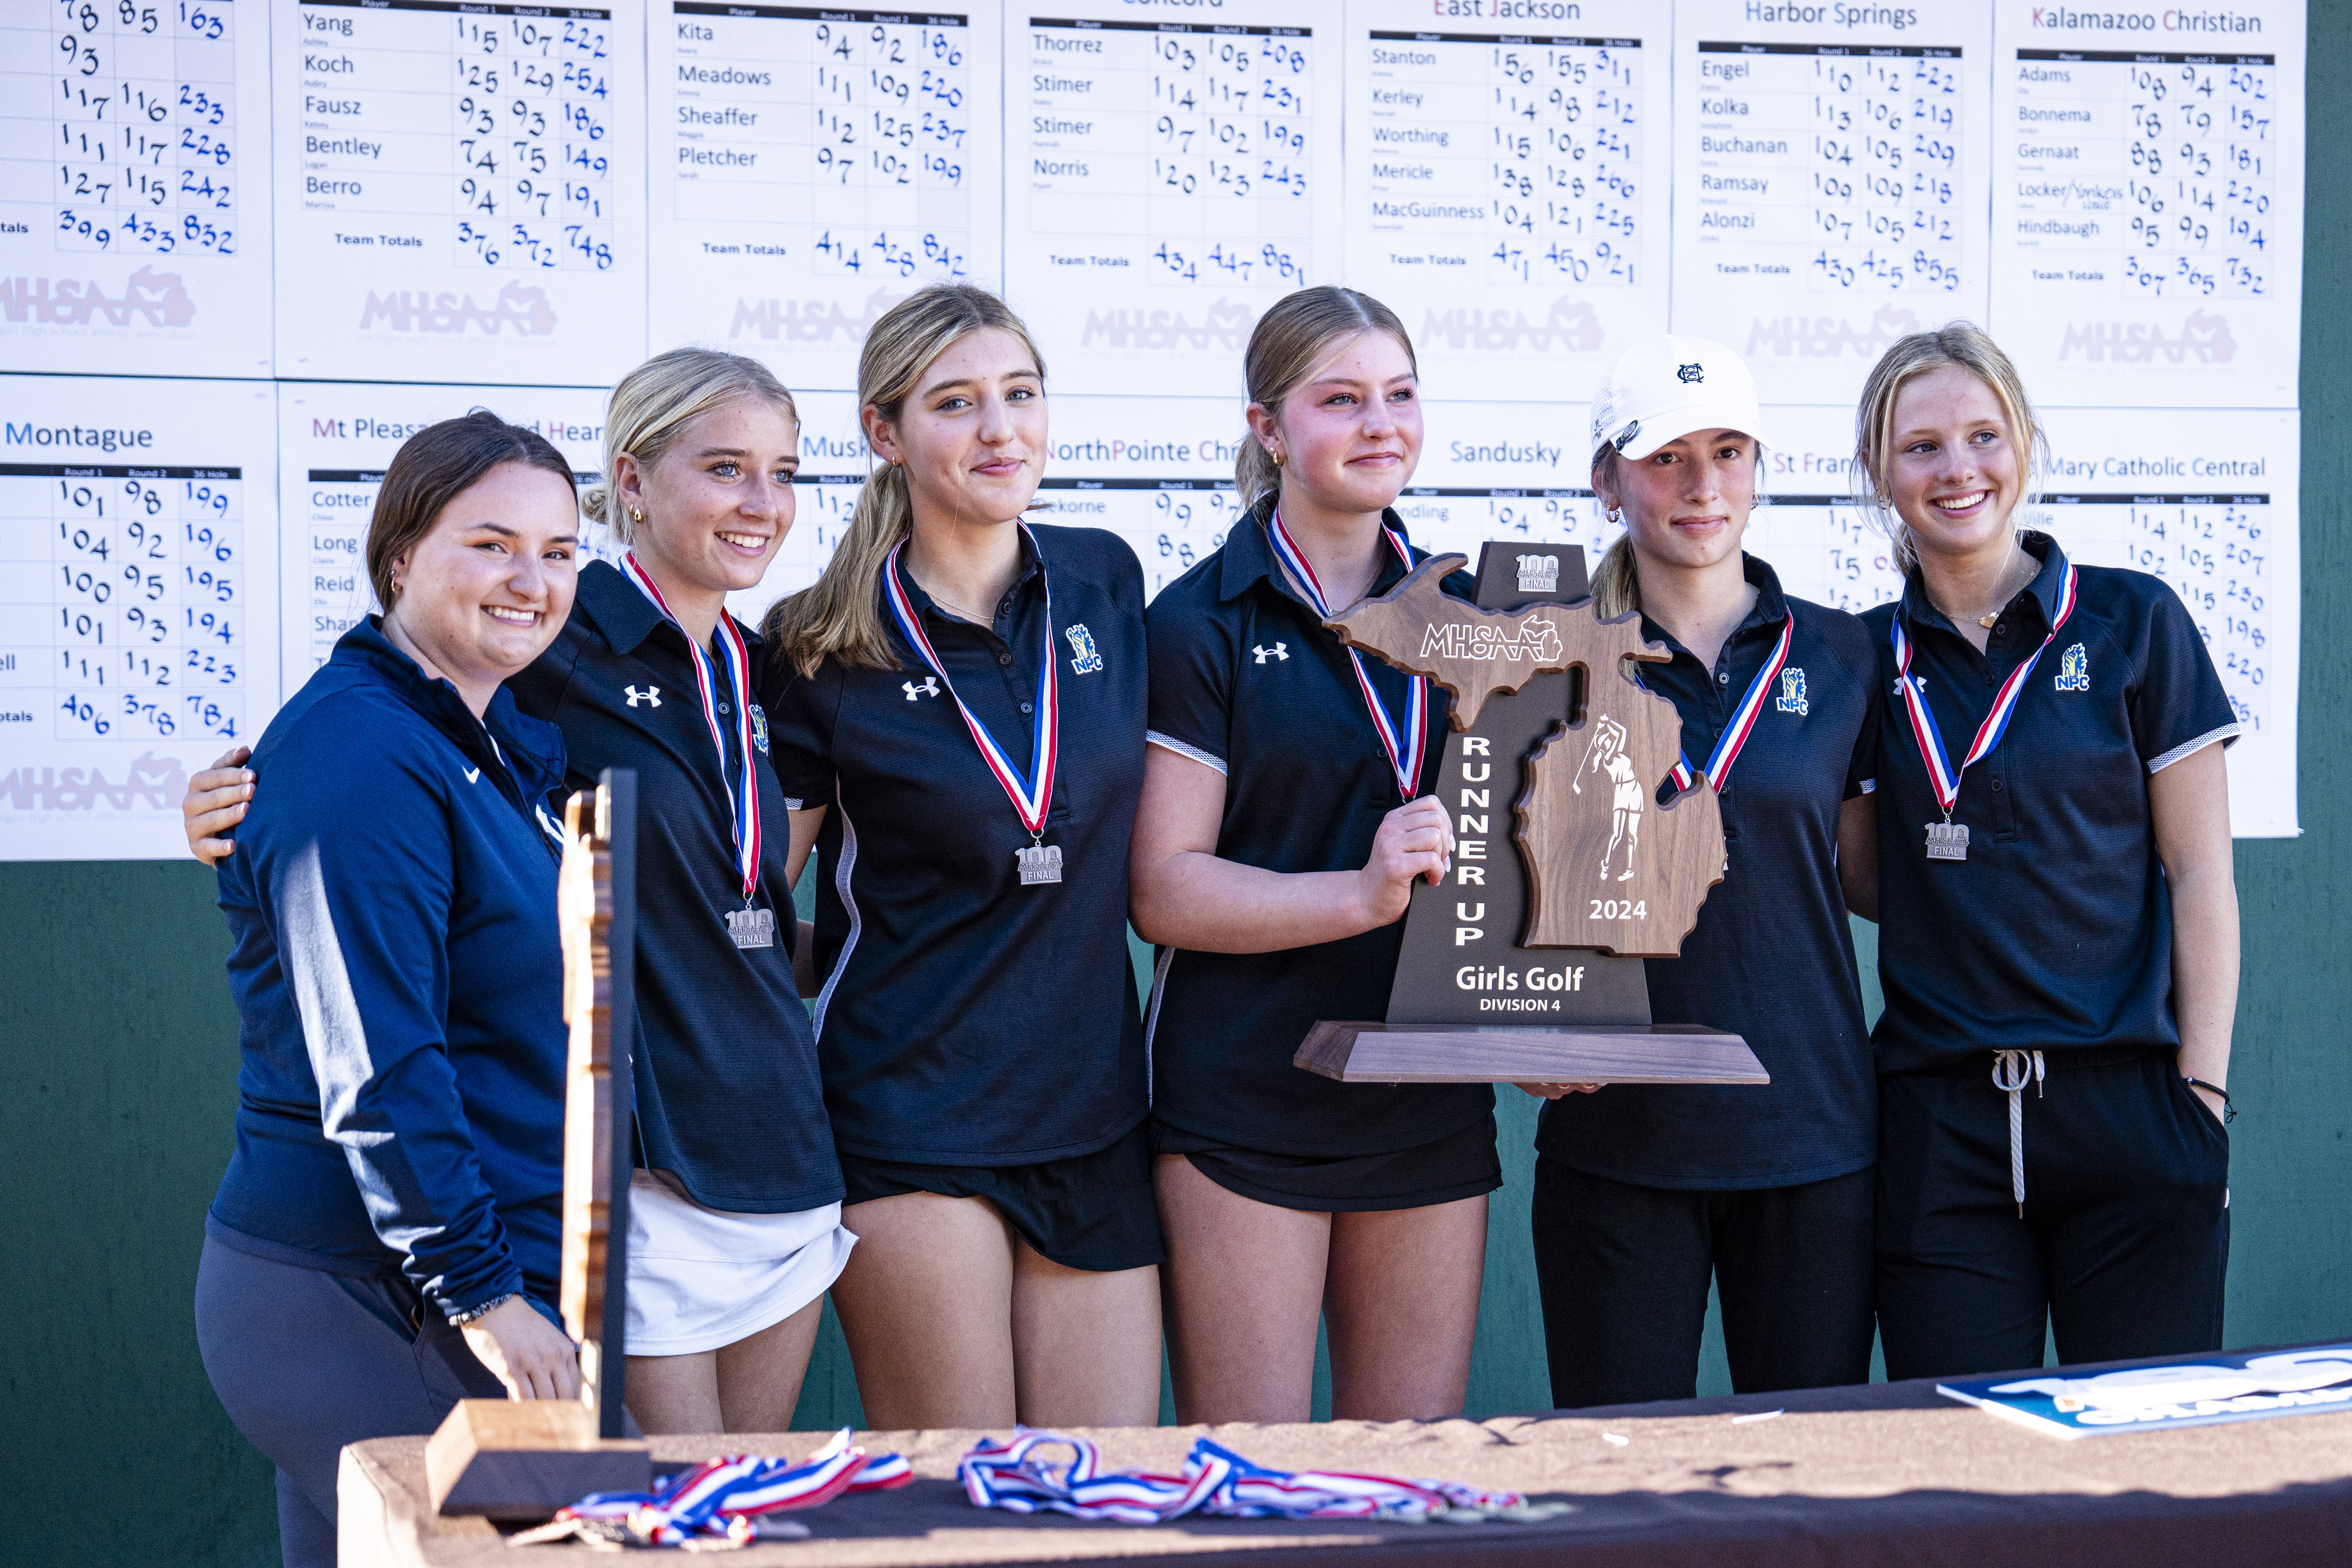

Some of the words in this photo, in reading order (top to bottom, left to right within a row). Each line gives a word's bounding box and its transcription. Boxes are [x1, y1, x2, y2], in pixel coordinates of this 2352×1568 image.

[459, 6, 489, 15] Round
[490, 6, 499, 15] 1
[513, 7, 542, 16] Round
[543, 7, 551, 17] 2
[568, 10, 583, 20] 36
[583, 9, 604, 20] Hole
[1435, 0, 1482, 17] East
[1490, 0, 1580, 20] Jackson
[1746, 2, 1826, 24] Harbor
[1834, 2, 1918, 30] Springs
[2032, 6, 2156, 31] Kalamazoo
[2163, 9, 2261, 33] Christian
[179, 0, 227, 40] 163
[303, 12, 353, 37] Yang
[457, 14, 500, 54] 115
[512, 16, 556, 57] 107
[563, 20, 609, 59] 222
[678, 24, 713, 41] Kita
[303, 38, 329, 47] Ashley
[816, 24, 852, 60] 94
[871, 25, 905, 64] 92
[922, 29, 962, 67] 186
[1033, 34, 1103, 53] Thorrez
[60, 32, 99, 77] 93
[304, 55, 354, 73] Koch
[1372, 48, 1436, 65] Stanton
[678, 65, 771, 86] Meadows
[1494, 48, 1534, 85] 156
[1548, 50, 1587, 85] 155
[1595, 49, 1630, 86] 311
[1702, 60, 1749, 80] Engel
[2018, 67, 2071, 83] Adams
[1033, 74, 1093, 93] Stimer
[305, 95, 361, 115] Fausz
[1372, 89, 1423, 107] Kerley
[1702, 99, 1749, 115] Kolka
[678, 106, 758, 126] Sheaffer
[2018, 106, 2091, 123] Bonnema
[1033, 116, 1092, 135] Stimer
[1372, 127, 1449, 147] Worthing
[1701, 136, 1788, 154] Buchanan
[306, 135, 381, 160] Bentley
[679, 147, 757, 167] Pletcher
[2018, 143, 2079, 159] Gernaat
[460, 139, 498, 175] 74
[513, 141, 547, 174] 75
[565, 143, 608, 178] 149
[817, 147, 854, 185] 97
[873, 150, 909, 185] 102
[924, 153, 962, 186] 199
[1034, 159, 1089, 176] Norris
[1373, 163, 1433, 179] Mericle
[61, 165, 112, 204] 127
[126, 167, 167, 206] 115
[181, 169, 231, 208] 242
[306, 176, 362, 196] Berro
[1702, 173, 1769, 195] Ramsay
[1372, 201, 1484, 219] MacGuinness
[1701, 212, 1754, 229] Alonzi
[2018, 221, 2099, 239] Hindbaugh
[59, 210, 111, 249] 399
[122, 213, 176, 253] 433
[183, 214, 234, 254] 832
[334, 233, 374, 245] Team
[379, 235, 423, 248] Totals
[458, 222, 500, 266] 376
[512, 223, 555, 268] 372
[564, 225, 613, 270] 748
[703, 242, 740, 254] Team
[745, 244, 786, 255] Totals
[815, 231, 861, 272] 414
[872, 232, 915, 277] 428
[923, 233, 966, 276] 842
[1050, 255, 1085, 266] Team
[1090, 256, 1129, 267] Totals
[1153, 242, 1197, 282] 434
[1208, 244, 1253, 281] 447
[1262, 243, 1304, 286] 881
[1390, 254, 1424, 264] Team
[1429, 255, 1466, 266] Totals
[1492, 242, 1528, 281] 471
[1545, 242, 1589, 282] 450
[1595, 241, 1634, 284] 921
[1717, 263, 1749, 273] Team
[1754, 264, 1790, 274] Totals
[1814, 250, 1855, 287] 430
[1861, 249, 1904, 289] 425
[1913, 249, 1959, 291] 855
[2032, 269, 2064, 280] Team
[2068, 271, 2104, 281] Totals
[2126, 255, 2166, 296] 367
[2176, 256, 2215, 295] 365
[2227, 257, 2263, 295] 732
[6, 422, 153, 453] Montague
[313, 419, 346, 438] Mt
[1451, 441, 1561, 468] Sandusky
[1774, 452, 1795, 473] St
[63, 469, 97, 479] Round
[97, 469, 105, 478] 1
[127, 469, 161, 479] Round
[160, 470, 168, 479] 2
[192, 470, 207, 480] 36
[206, 472, 230, 480] Hole
[2103, 457, 2185, 477] Catholic
[2192, 457, 2265, 477] Central
[60, 479, 104, 518] 101
[125, 478, 163, 516] 98
[186, 479, 228, 518] 199
[312, 491, 370, 507] Cotter
[2130, 506, 2166, 540] 114
[2179, 507, 2214, 540] 112
[2225, 505, 2261, 540] 226
[313, 535, 358, 554] Long
[1515, 554, 1559, 573] 100
[1516, 568, 1559, 578] MHSAA
[62, 565, 111, 604] 100
[124, 564, 164, 601] 95
[186, 565, 234, 602] 195
[315, 576, 355, 592] Reid
[1525, 579, 1549, 588] FINAL
[1420, 621, 1547, 662] MHSAA
[1071, 653, 1103, 675] NPC
[2055, 675, 2090, 691] NPC
[61, 694, 110, 735] 406
[124, 693, 176, 736] 378
[186, 695, 237, 739] 784
[1776, 697, 1808, 716] NPC
[753, 734, 769, 757] NP
[1457, 736, 1491, 885] RUNNER
[1925, 823, 1969, 842] 100
[1925, 837, 1969, 847] MHSAA
[1015, 845, 1062, 865] 100
[1934, 846, 1959, 856] FINAL
[1017, 861, 1063, 871] MHSAA
[1028, 870, 1054, 881] FINAL
[724, 909, 774, 928] 100
[1590, 899, 1647, 920] 2024
[728, 924, 774, 935] MHSAA
[1456, 902, 1485, 946] UP
[738, 934, 765, 945] FINAL
[1456, 965, 1519, 991] Girls
[1525, 966, 1585, 991] Golf
[1480, 999, 1548, 1011] DIVISION
[1551, 1000, 1561, 1011] 4
